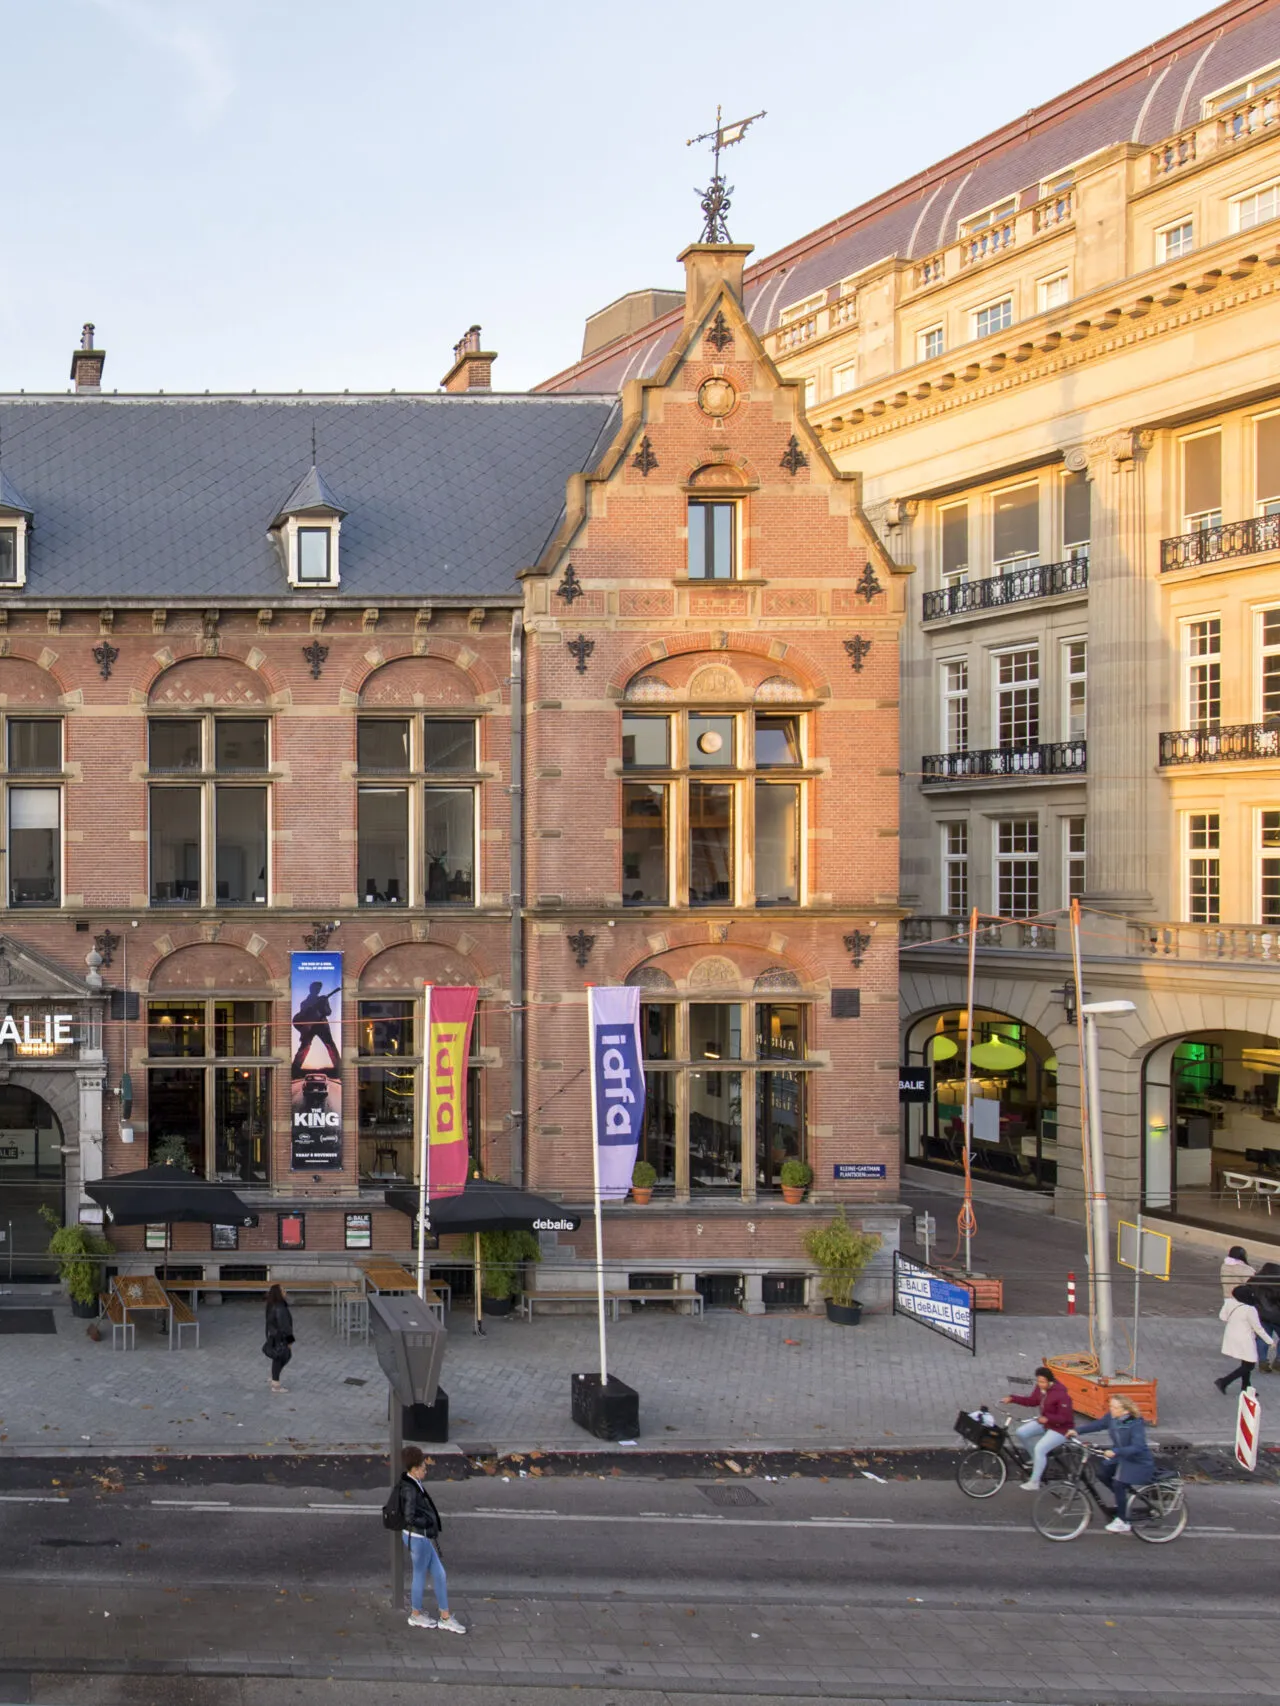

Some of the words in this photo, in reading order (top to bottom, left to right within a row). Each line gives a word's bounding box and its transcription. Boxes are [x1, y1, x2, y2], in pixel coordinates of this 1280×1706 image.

[436, 1034, 457, 1132] idfa
[602, 1035, 636, 1135] idfa
[294, 1112, 340, 1126] KING
[532, 1218, 574, 1230] debalie
[917, 1302, 950, 1317] deBALIE
